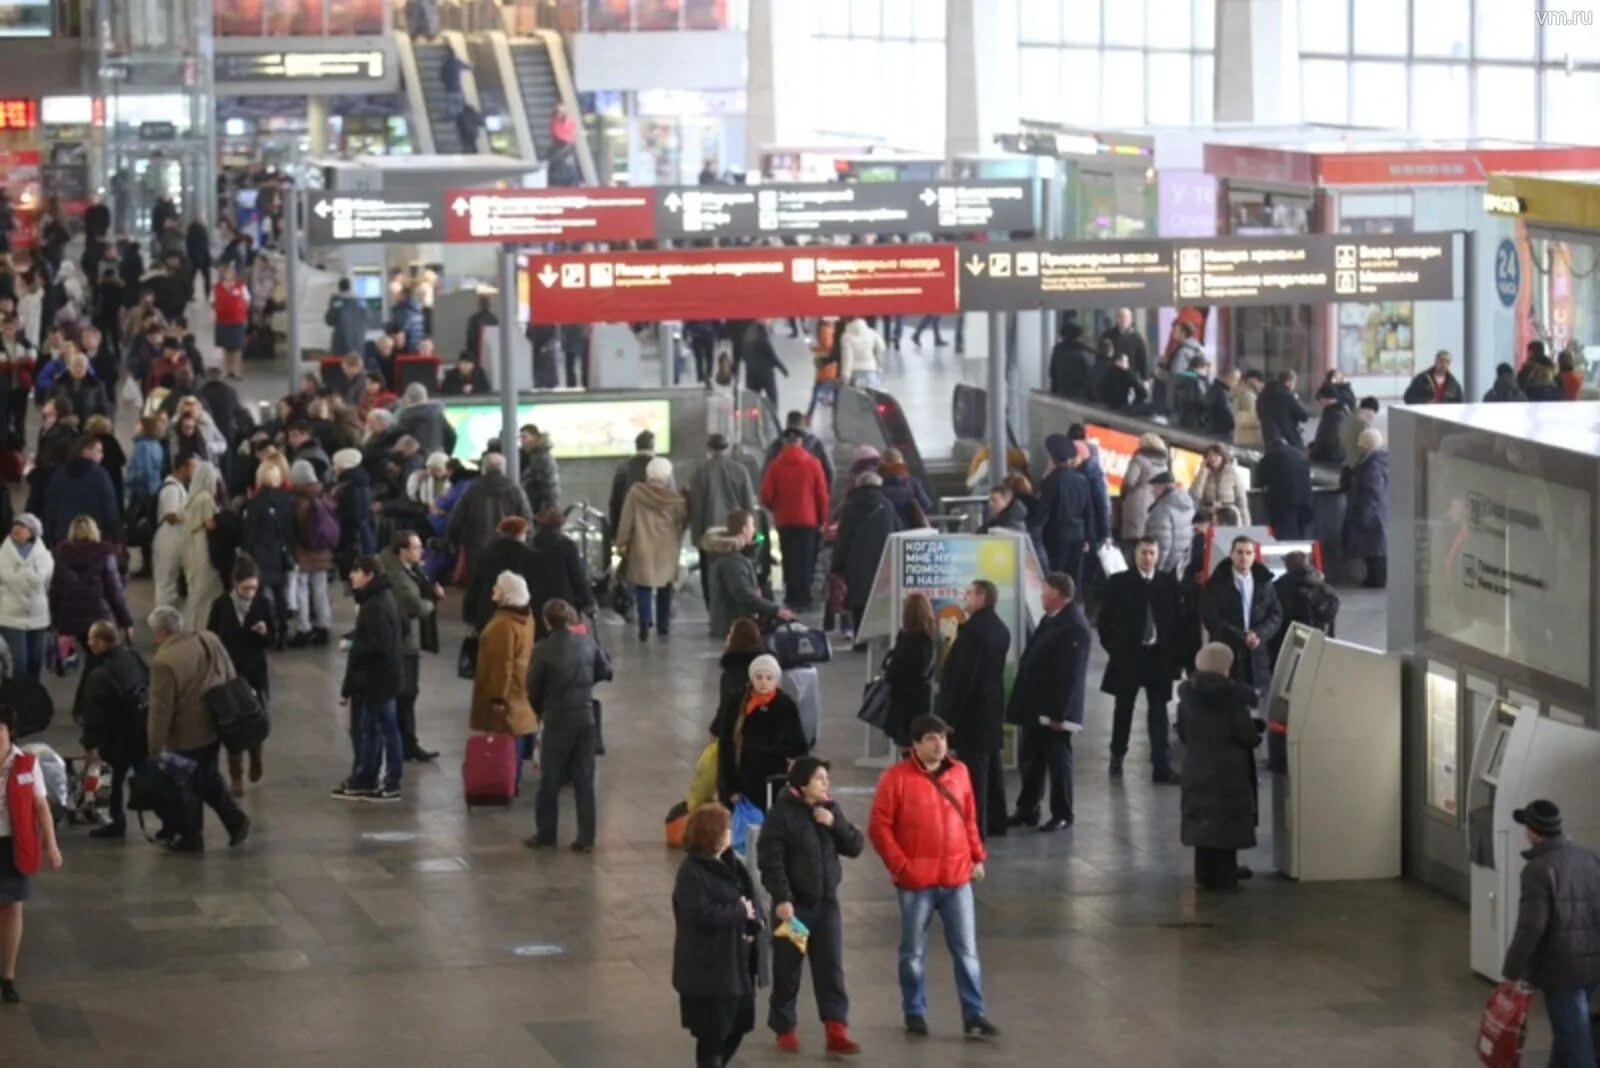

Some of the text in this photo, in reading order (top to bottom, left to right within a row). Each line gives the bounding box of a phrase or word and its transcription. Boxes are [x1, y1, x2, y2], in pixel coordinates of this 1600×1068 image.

[1499, 249, 1516, 279] 24
[905, 541, 945, 553] КОГДА
[905, 553, 930, 563] МНЕ
